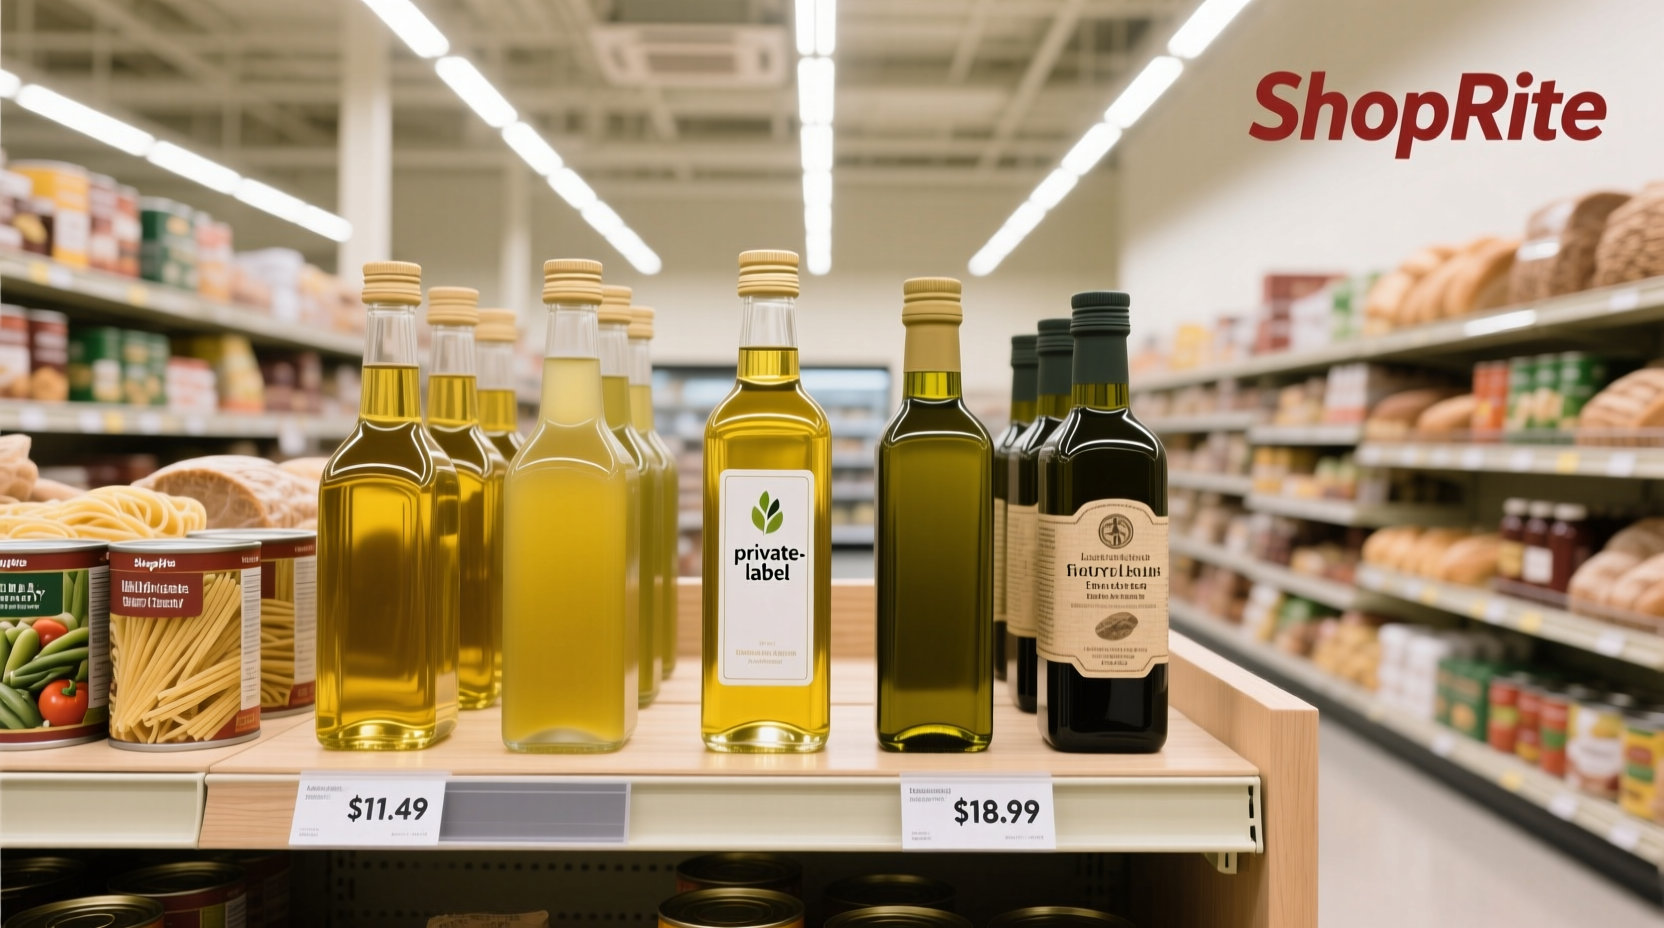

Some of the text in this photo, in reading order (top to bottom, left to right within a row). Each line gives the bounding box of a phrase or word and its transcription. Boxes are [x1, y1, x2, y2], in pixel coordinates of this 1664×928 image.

[1248, 71, 1607, 160] ShopRite
[734, 544, 805, 575] private-
[746, 563, 790, 580] label
[347, 794, 428, 822] $11.49
[954, 797, 1040, 826] $18.99
